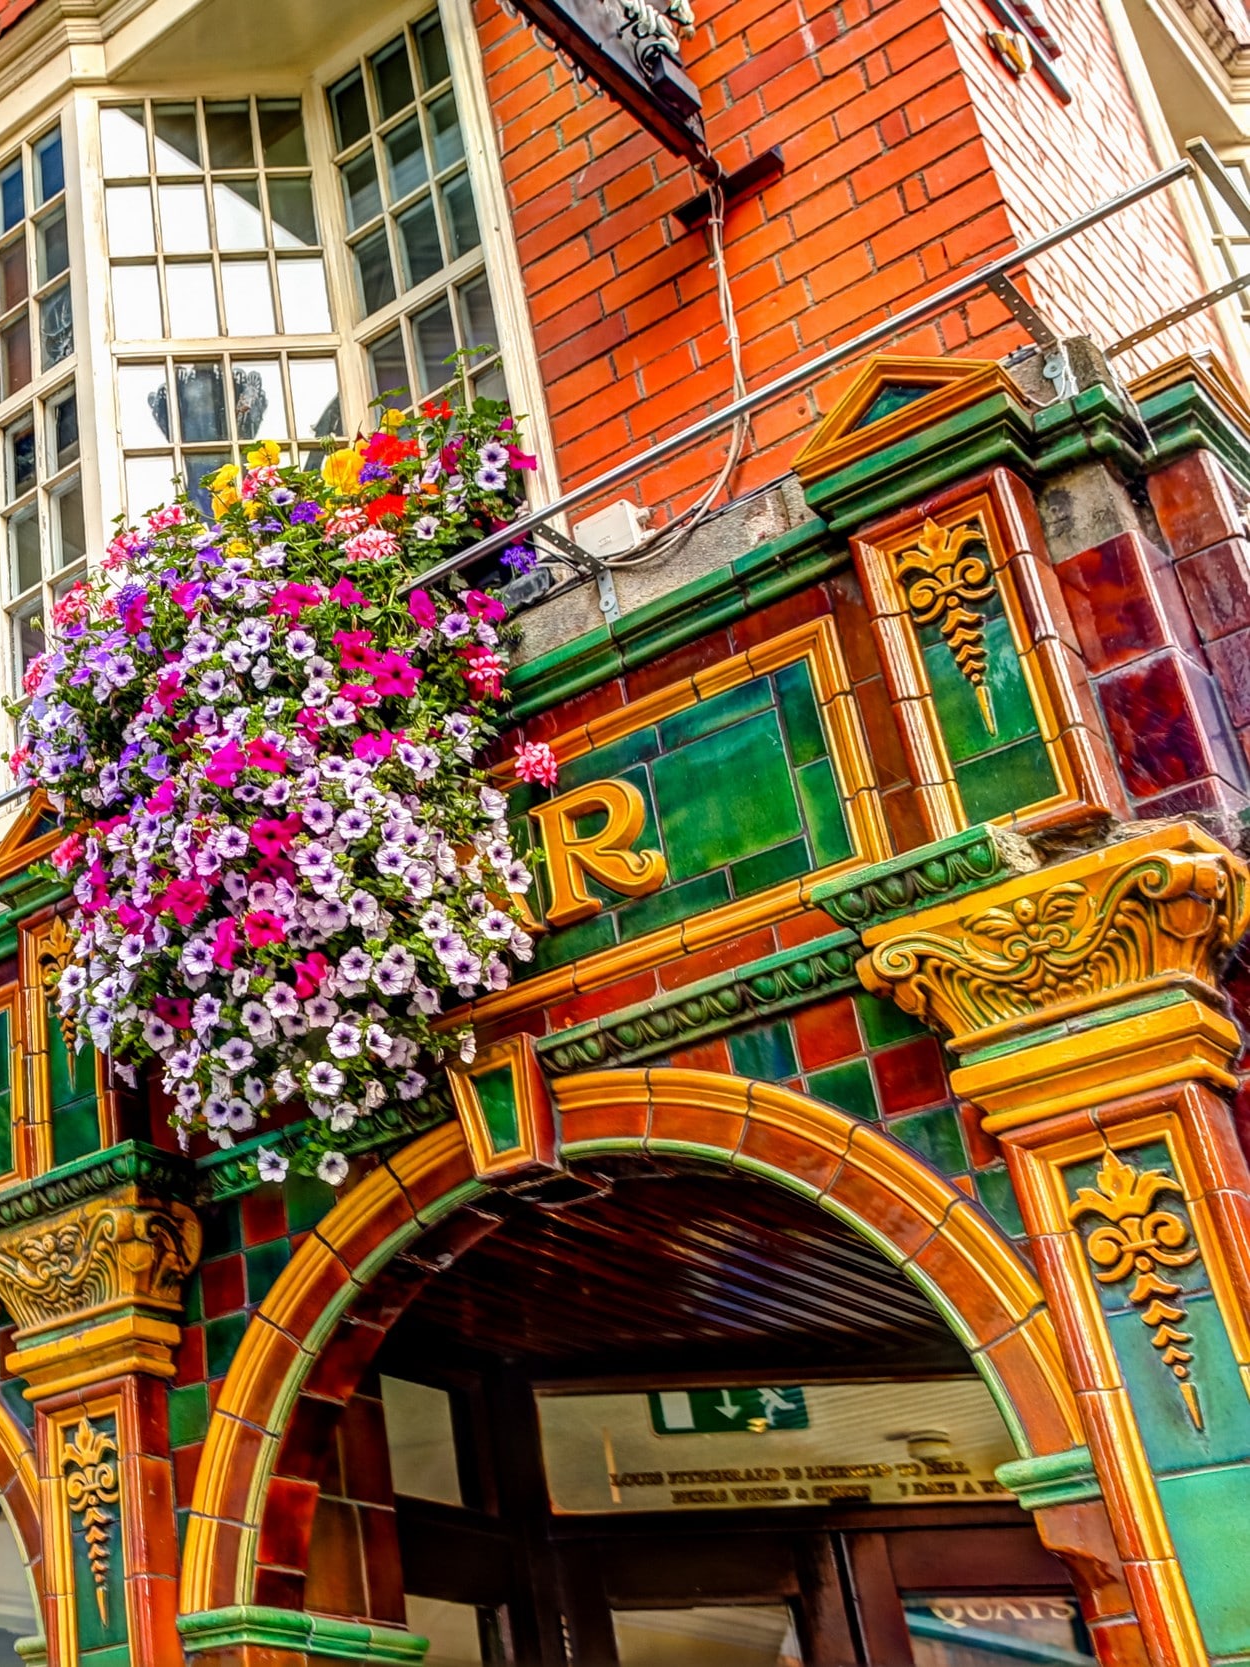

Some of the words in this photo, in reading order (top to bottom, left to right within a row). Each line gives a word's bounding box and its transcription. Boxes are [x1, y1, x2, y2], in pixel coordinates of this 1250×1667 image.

[609, 1471, 664, 1487] LOUIS
[894, 1462, 922, 1476] TO
[730, 1486, 791, 1502] WINES
[913, 1480, 958, 1495] DAYS
[961, 1480, 978, 1494] A
